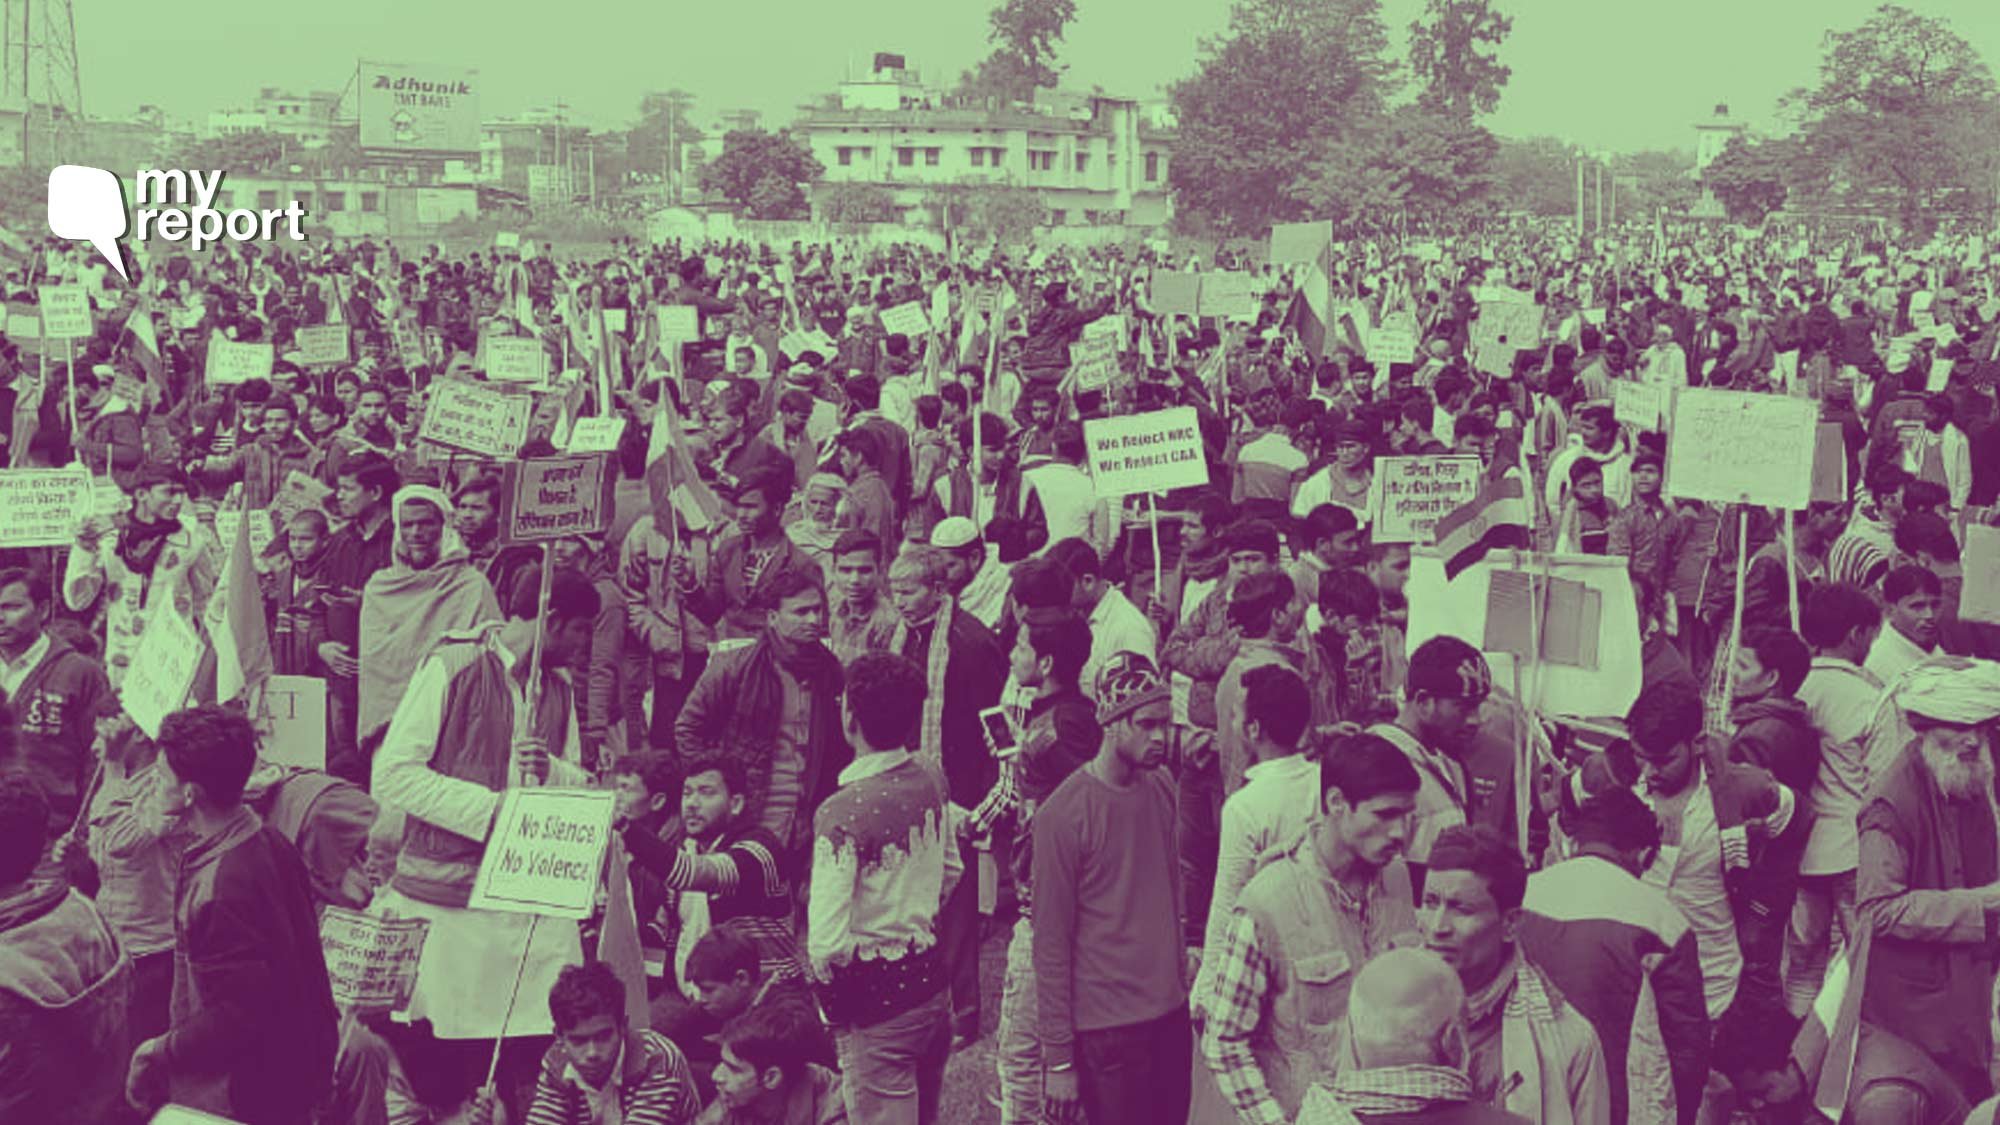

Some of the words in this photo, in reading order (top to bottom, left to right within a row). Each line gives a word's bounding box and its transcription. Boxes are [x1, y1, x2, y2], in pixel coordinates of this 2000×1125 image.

[373, 75, 472, 95] Adhunik
[1122, 431, 1165, 448] Reject
[517, 812, 540, 839] No
[499, 847, 523, 874] No
